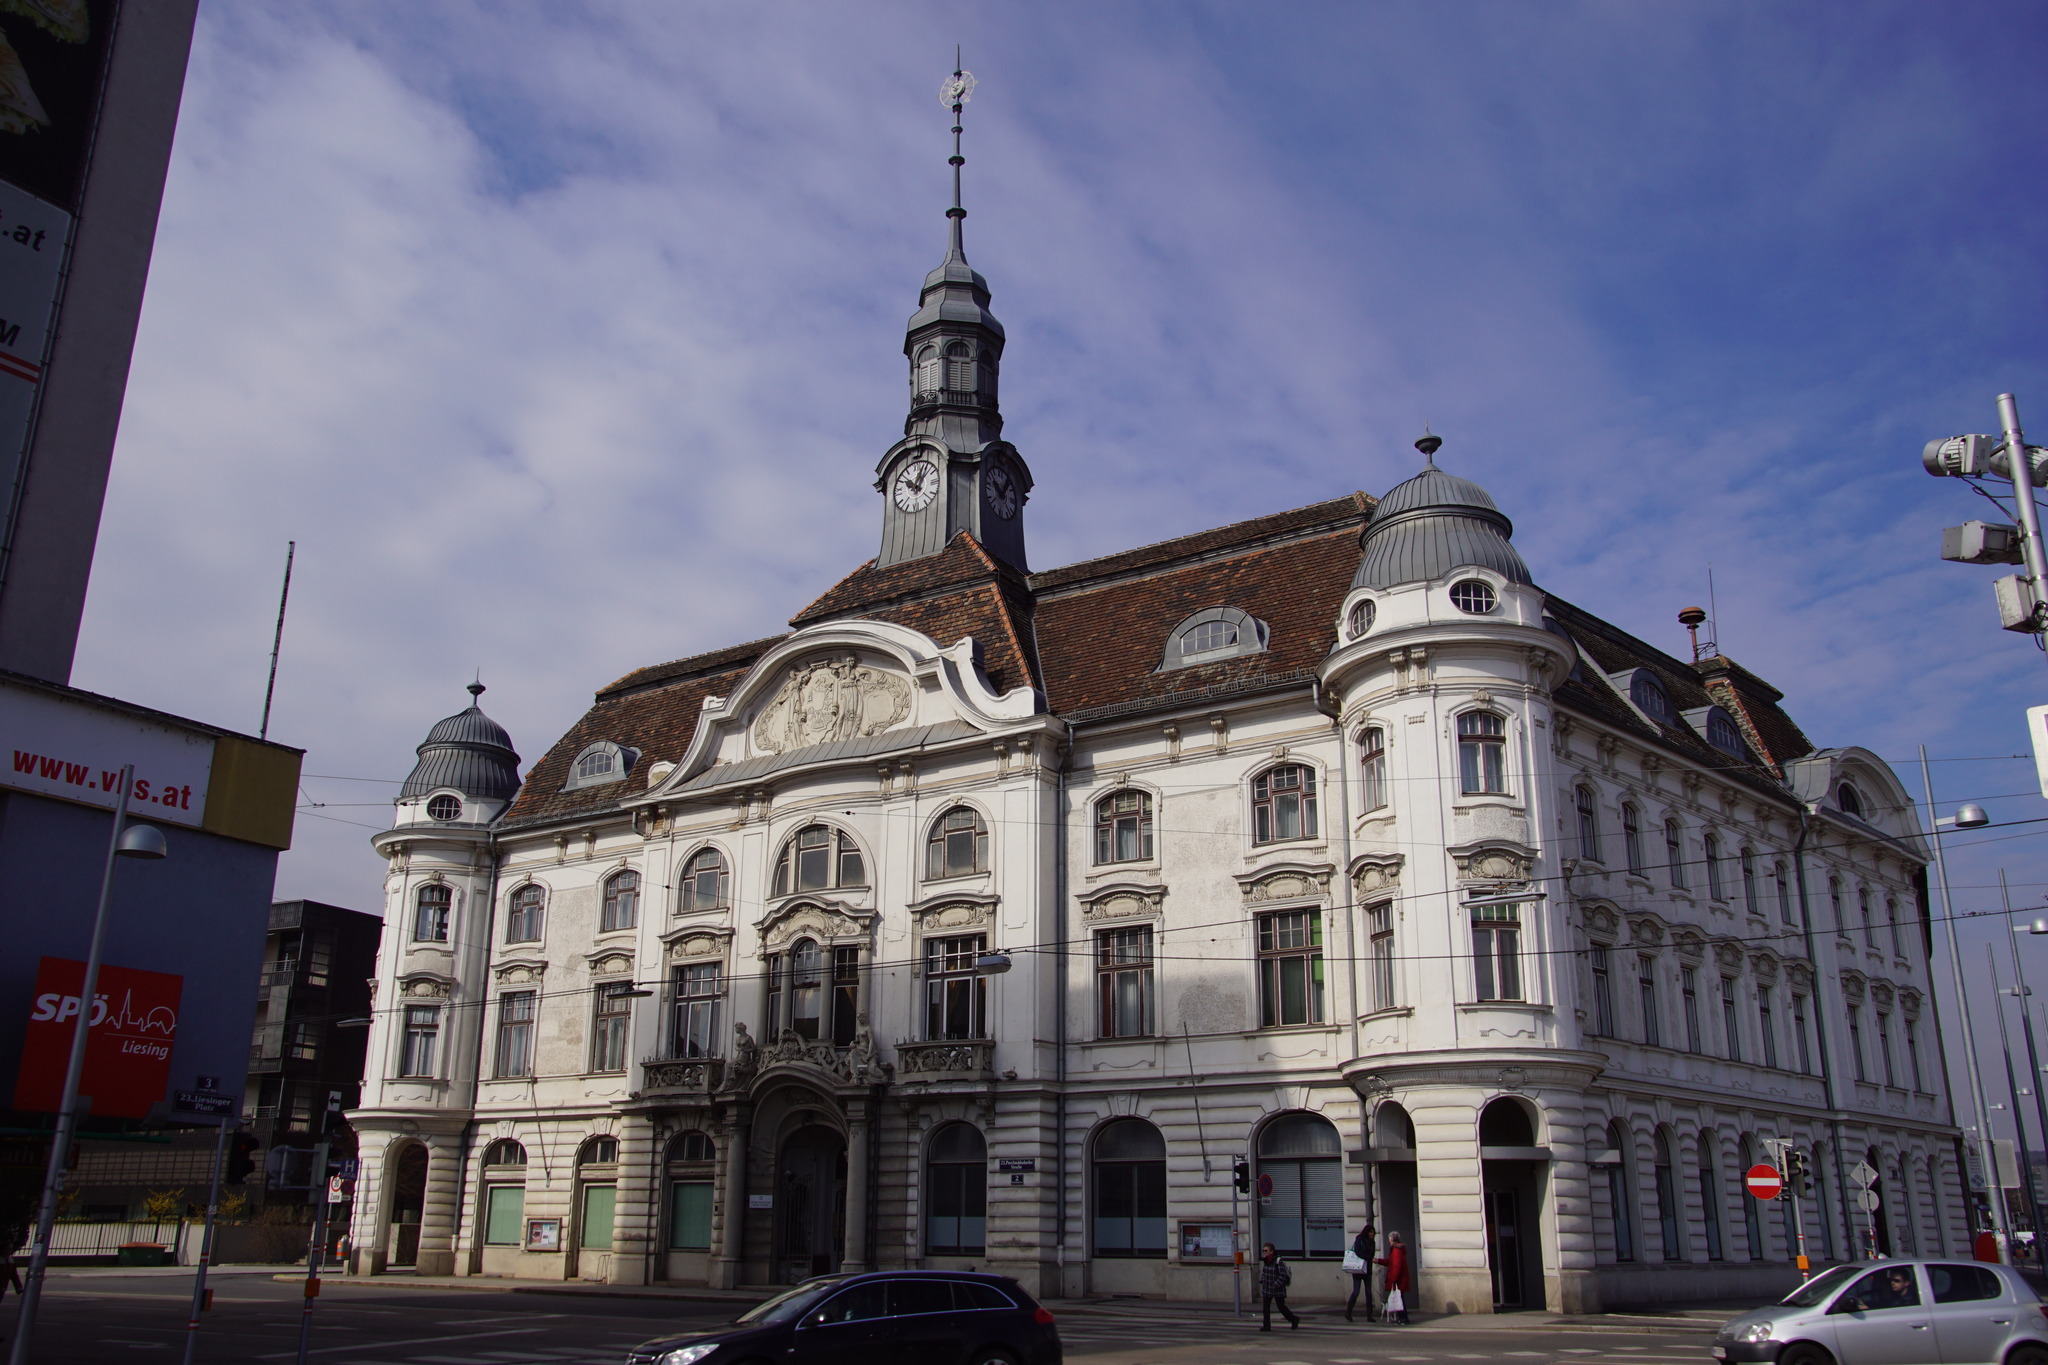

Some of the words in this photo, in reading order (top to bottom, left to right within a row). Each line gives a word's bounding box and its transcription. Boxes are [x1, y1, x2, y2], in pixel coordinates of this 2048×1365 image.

[0, 209, 46, 252] .at
[31, 993, 109, 1027] SPÖ
[121, 1039, 169, 1061] Liesing
[204, 1078, 213, 1088] 3
[194, 1103, 215, 1111] Platz
[345, 1160, 355, 1172] H
